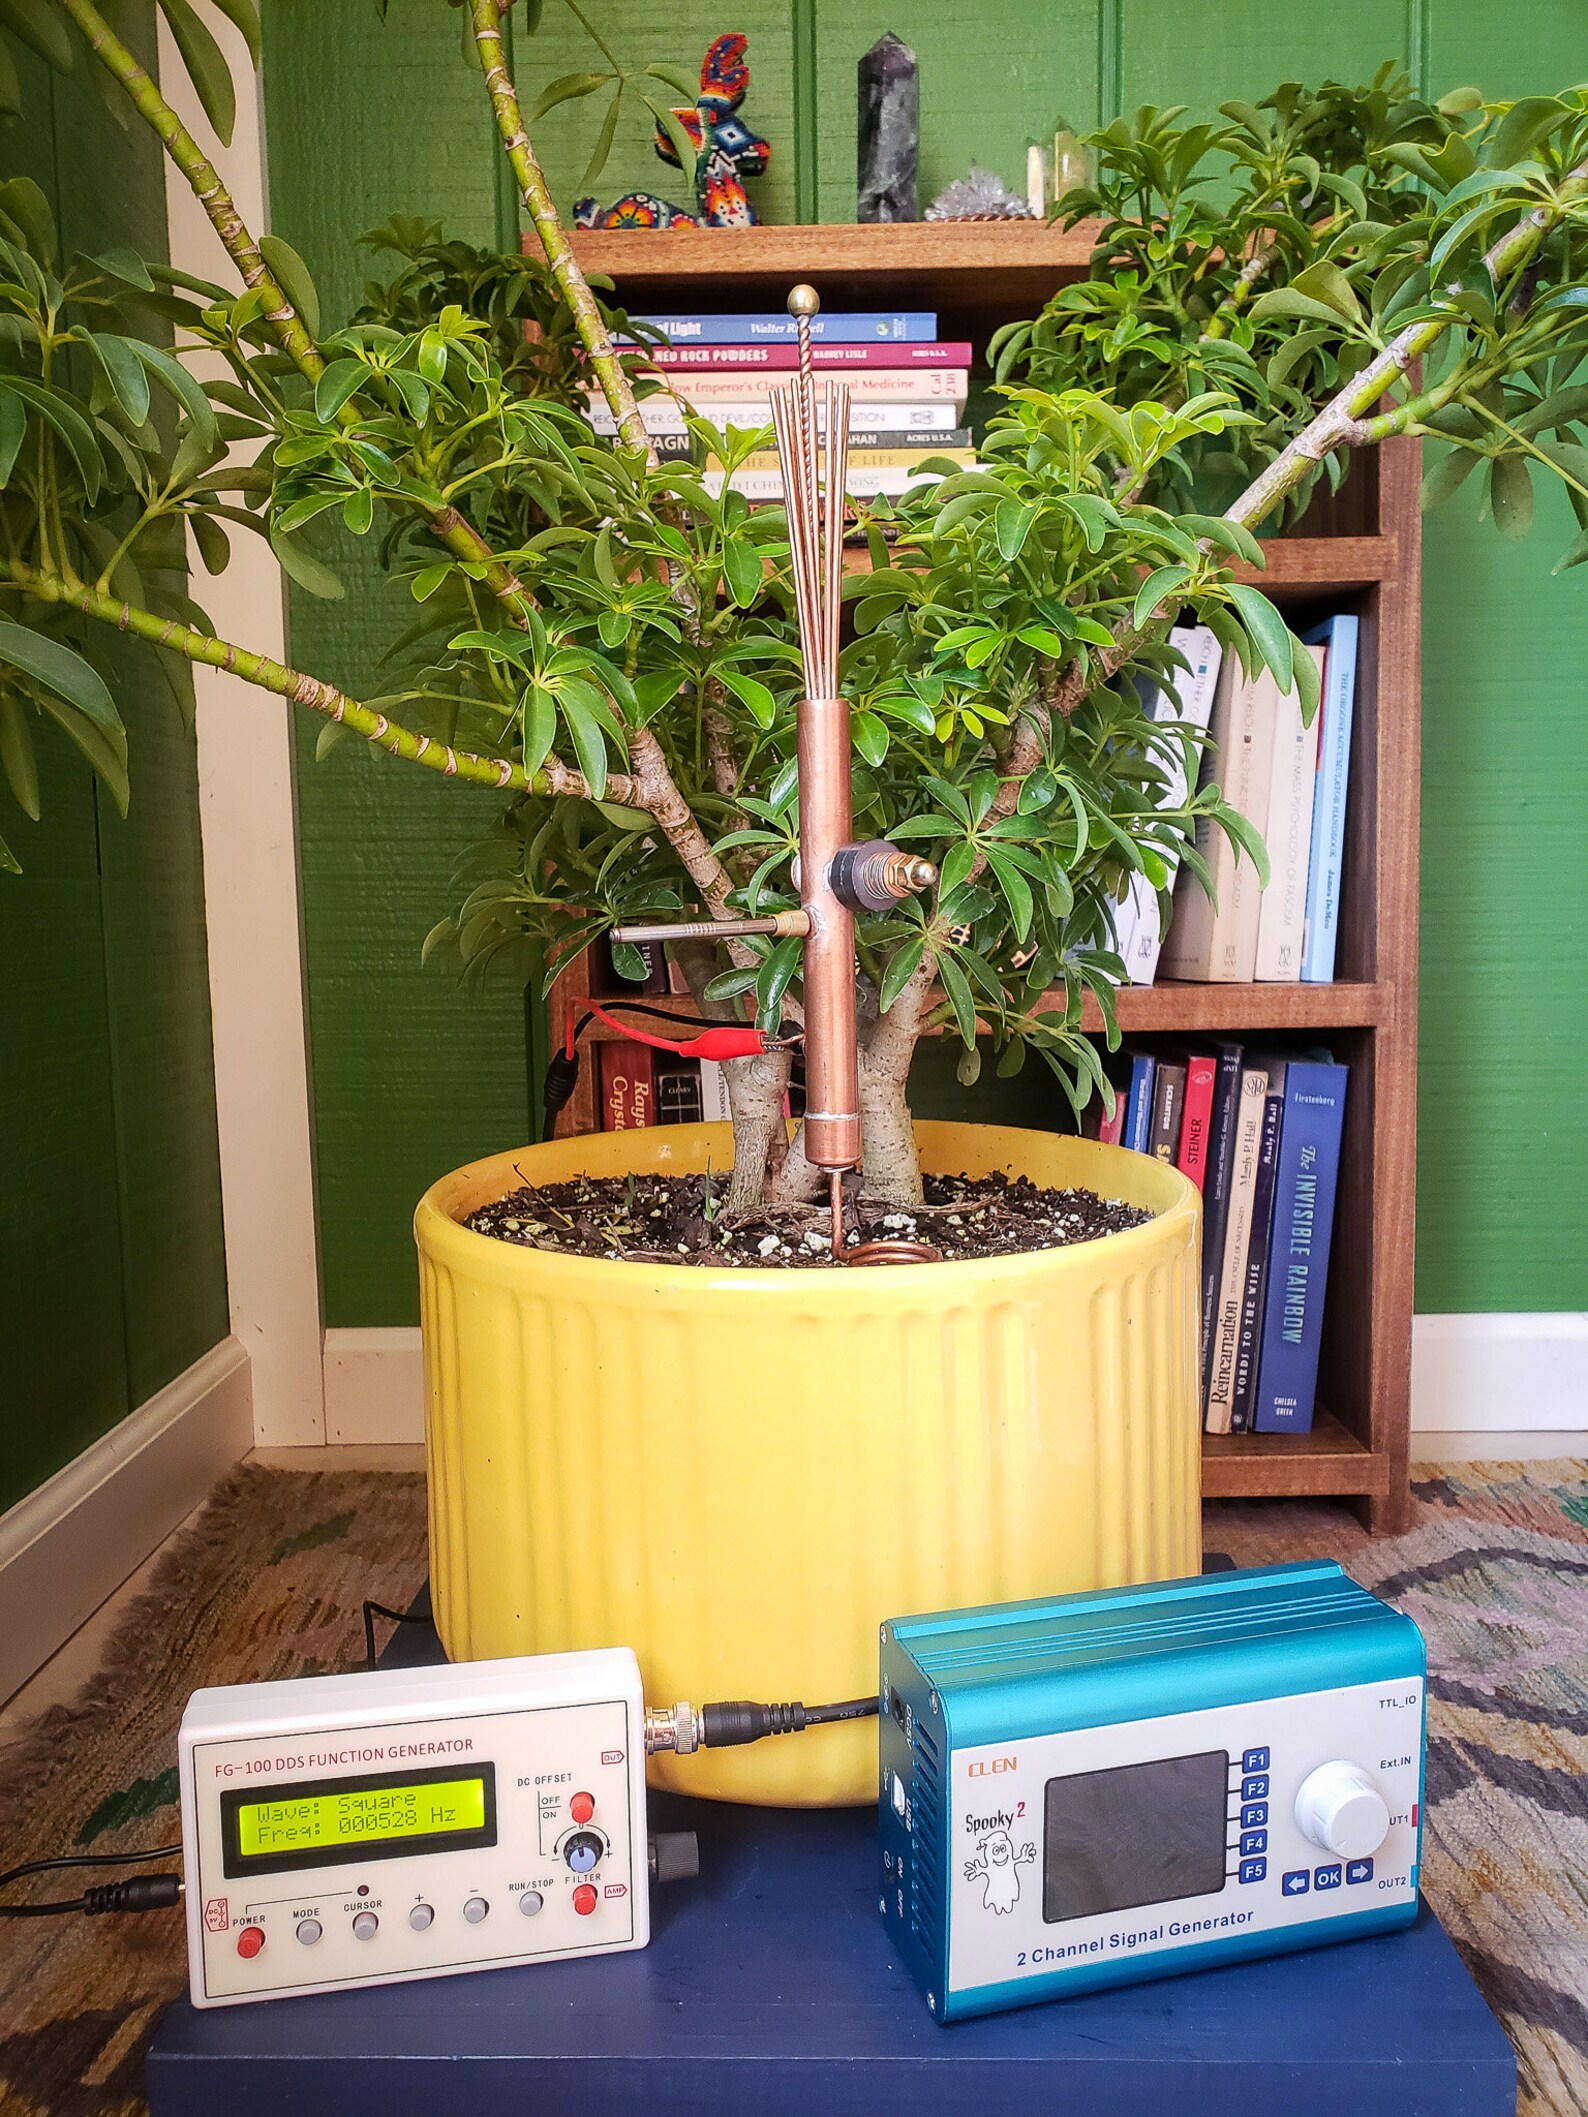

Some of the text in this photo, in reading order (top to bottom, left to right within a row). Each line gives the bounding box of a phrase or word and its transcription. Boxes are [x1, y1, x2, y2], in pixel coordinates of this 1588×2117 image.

[669, 321, 702, 336] Light
[751, 322, 786, 335] Walter
[680, 350, 710, 362] ROCK
[713, 349, 769, 362] POWDERS
[694, 381, 752, 394] Emperor's
[862, 379, 915, 390] Medicine
[863, 455, 895, 466] LIFE
[1340, 672, 1350, 691] THE
[1333, 734, 1346, 803] ACCUMULATOR
[1292, 764, 1302, 794] MASS
[1288, 796, 1301, 866] PSYCHOLOGY
[1328, 805, 1341, 858] HANDBOOK
[630, 1079, 649, 1128] Rays
[1294, 1092, 1336, 1106] Firstenberg
[1244, 1120, 1256, 1142] Hall
[1188, 1118, 1203, 1165] STEINER
[1282, 1145, 1317, 1344] The INVISIBLE RAINBOW
[1236, 1263, 1260, 1396] WORDS TO THE WISE
[1211, 1300, 1238, 1405] Reincarnation
[1379, 1696, 1417, 1709] TTL_IO
[215, 1738, 474, 1778] FG-100 DDS FUNCTION GENERATOR
[604, 1753, 621, 1762] OUT
[1248, 1758, 1265, 1769] F1
[1380, 1756, 1412, 1769] Ext.IN
[968, 1756, 1017, 1777] CLEN
[517, 1773, 573, 1787] DC OFFSET
[1248, 1785, 1265, 1796] F2
[541, 1795, 561, 1805] OFF
[257, 1793, 417, 1824] Wave: Square
[542, 1811, 557, 1820] ON
[905, 1798, 913, 1833] USB
[1246, 1812, 1264, 1823] F3
[1389, 1815, 1410, 1827] UT1
[257, 1806, 456, 1845] Freq: 000528 Hz
[1246, 1840, 1264, 1851] F4
[565, 1873, 602, 1884] FILTER
[1245, 1867, 1263, 1878] F5
[1317, 1871, 1340, 1886] OK
[509, 1878, 554, 1892] RUN/STOP
[1378, 1876, 1407, 1890] OUT2
[607, 1886, 625, 1896] AMP
[343, 1899, 383, 1912] CURSOR
[293, 1907, 321, 1919] MODE
[232, 1914, 266, 1927] POWER
[1017, 1910, 1254, 1967] 2 Channel Signal Generator
